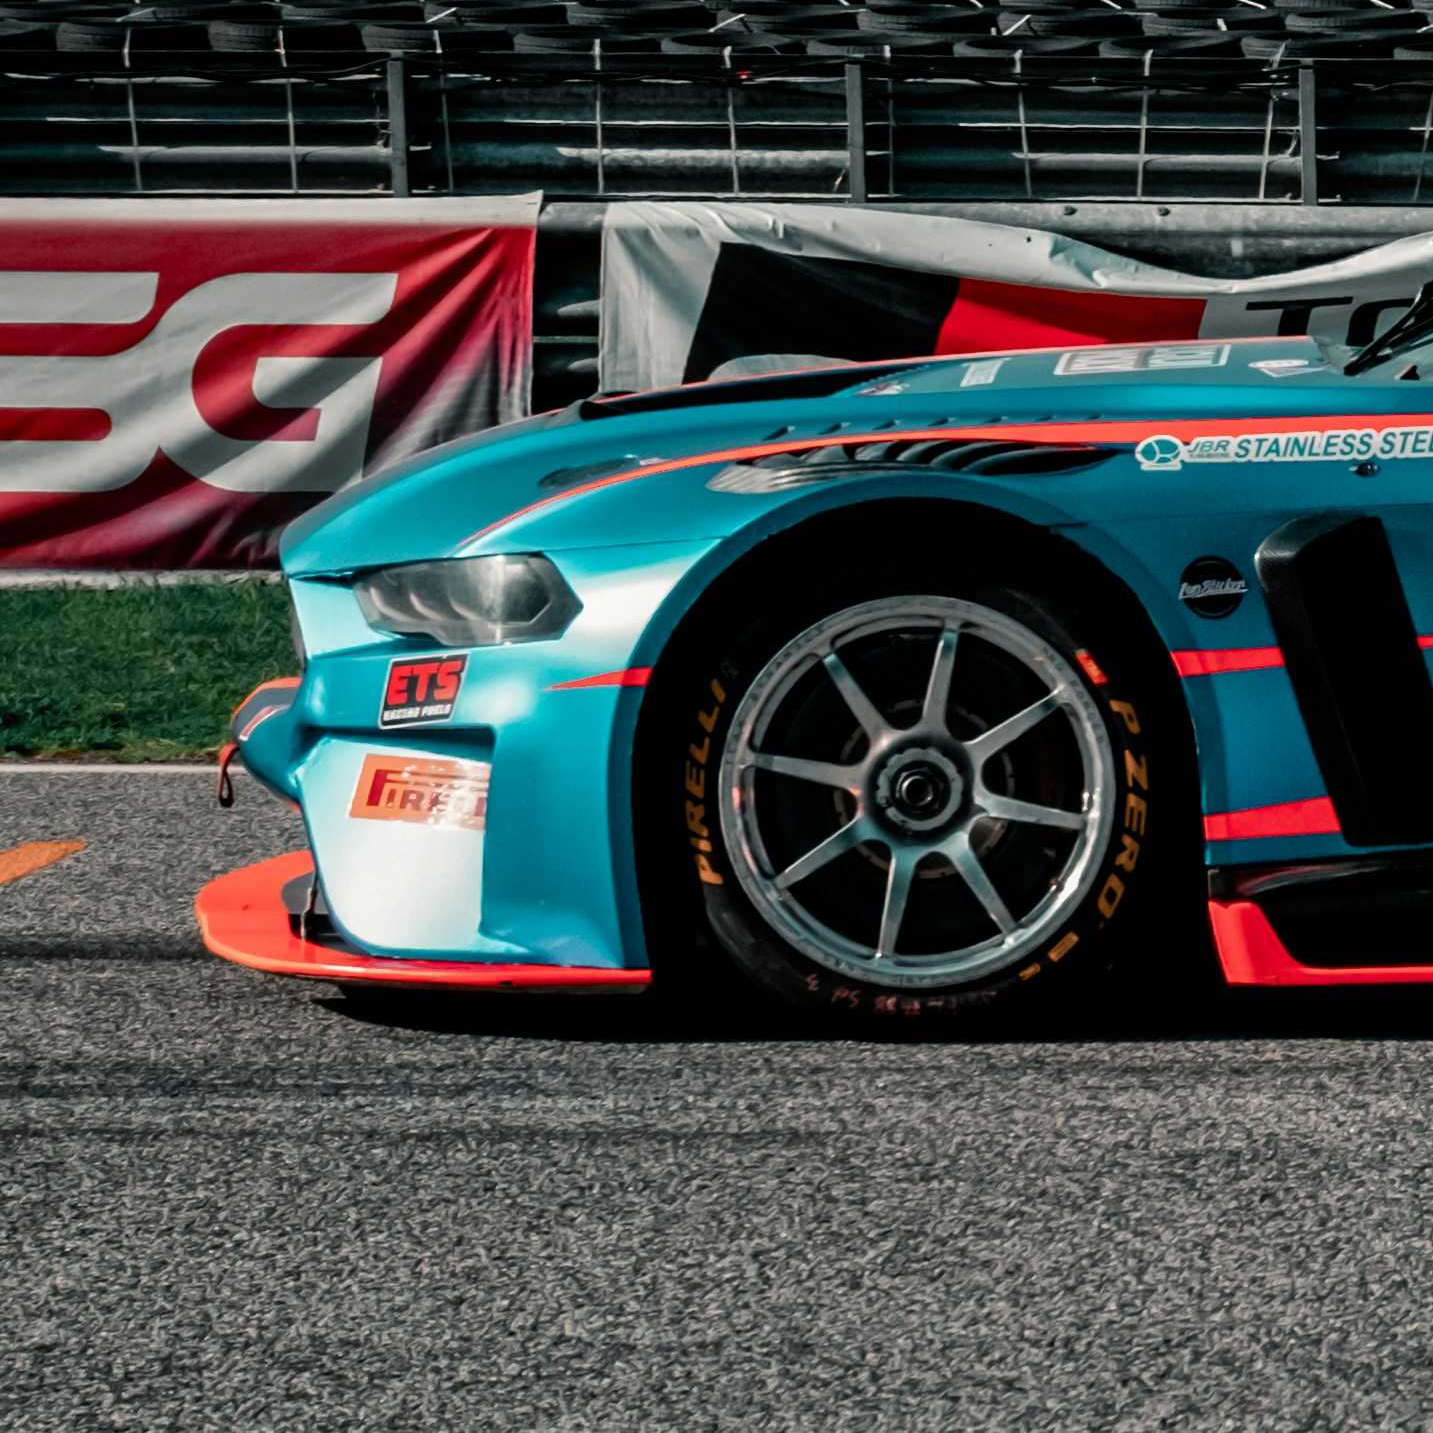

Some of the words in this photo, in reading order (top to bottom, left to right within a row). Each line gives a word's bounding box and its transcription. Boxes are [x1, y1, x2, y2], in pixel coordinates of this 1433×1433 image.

[1188, 440, 1230, 453] JBR
[1235, 432, 1373, 458] STAINLESS
[386, 660, 464, 706] ETS
[685, 677, 728, 886] PIRELLI
[1097, 748, 1149, 921] ZERO
